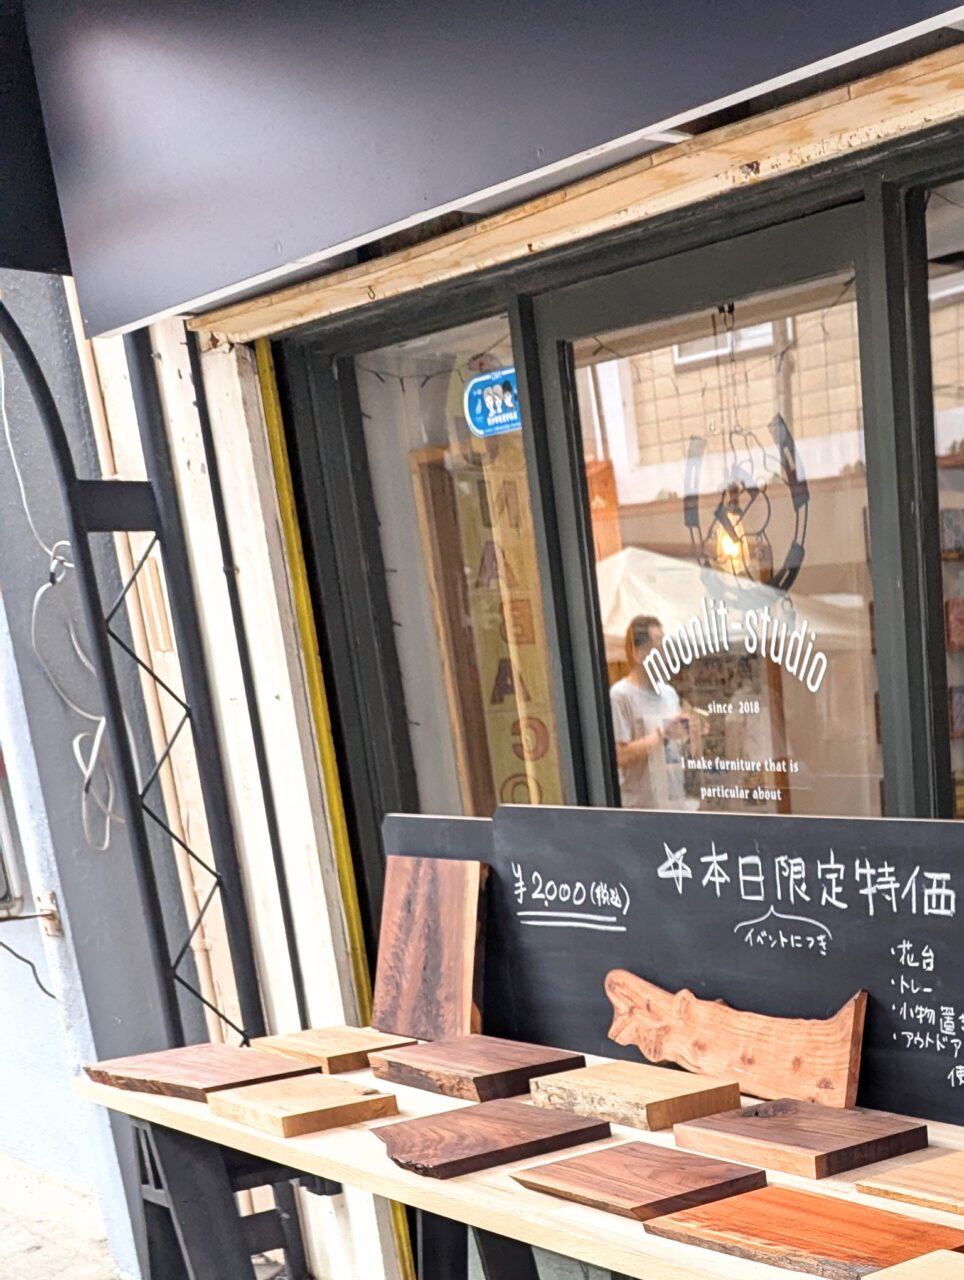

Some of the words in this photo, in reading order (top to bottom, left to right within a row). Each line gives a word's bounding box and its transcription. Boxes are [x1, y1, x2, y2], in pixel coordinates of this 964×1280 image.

[643, 596, 828, 696] moonlit-studio
[708, 701, 734, 714] since
[738, 701, 760, 714] 2018
[681, 757, 686, 769] I
[687, 758, 713, 770] make
[714, 756, 762, 772] furniture
[764, 758, 787, 773] that
[789, 759, 799, 773] is
[700, 785, 750, 800] particular
[752, 786, 782, 801] about
[744, 927, 829, 956] イベントにつき
